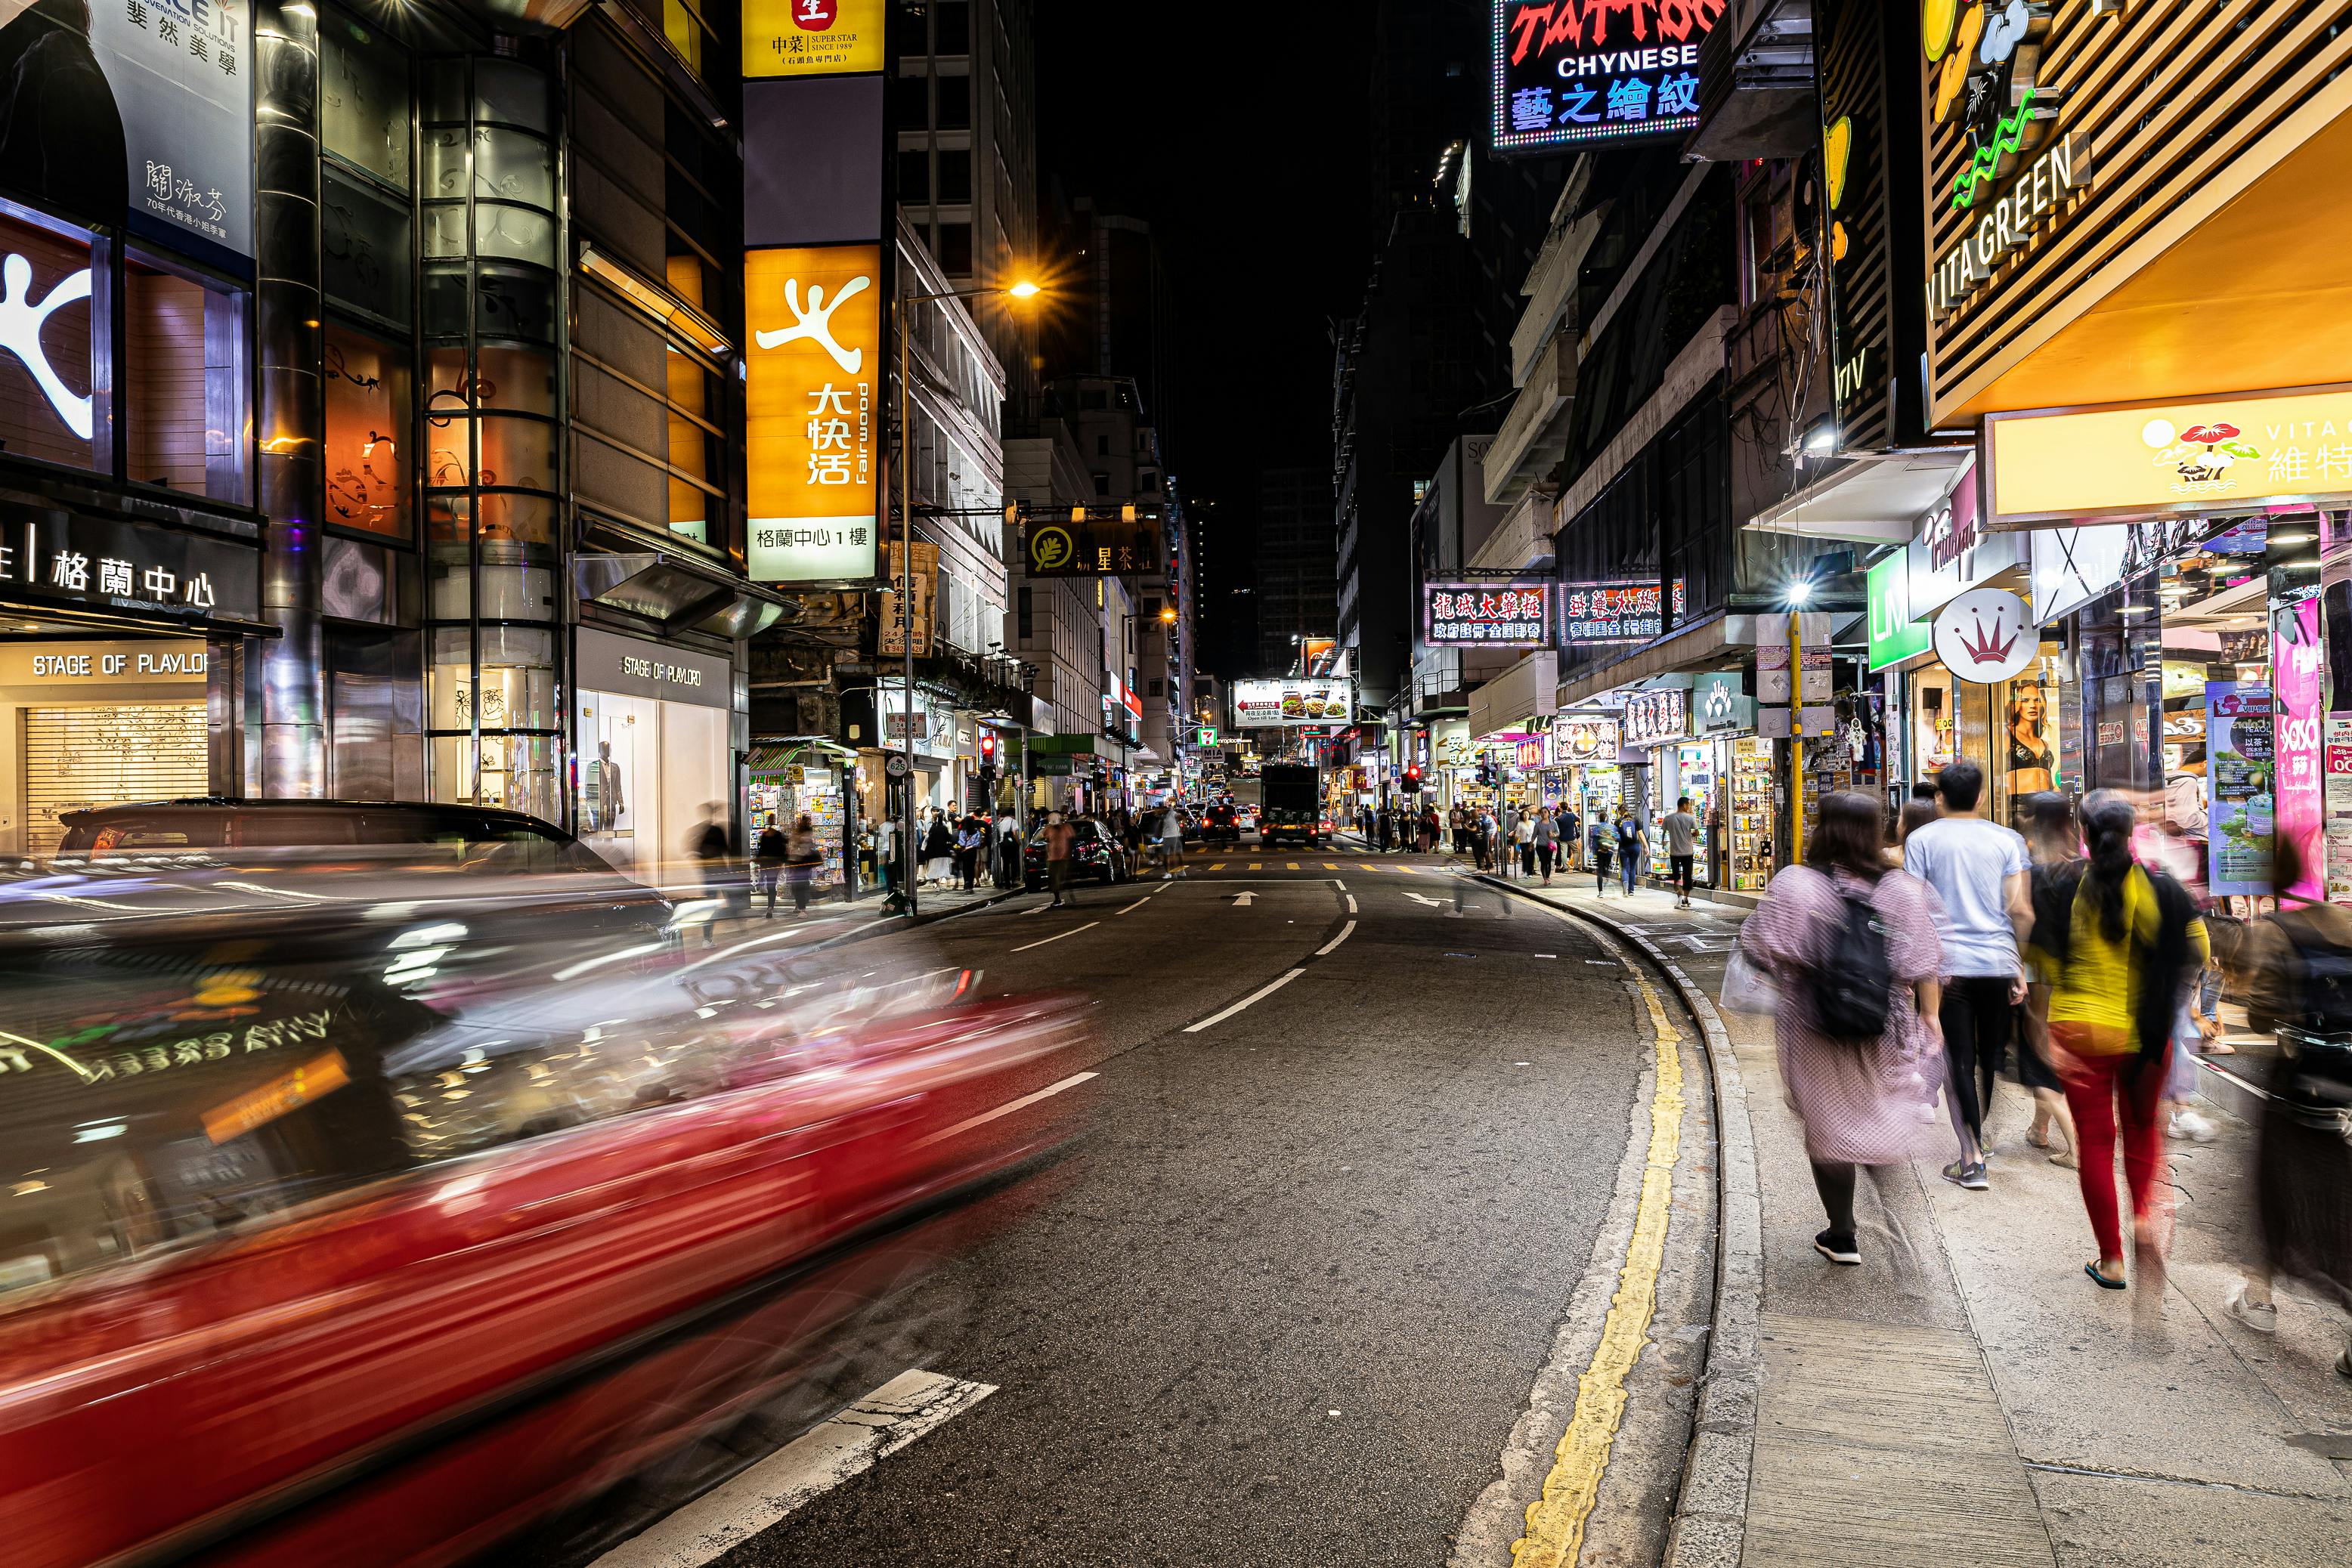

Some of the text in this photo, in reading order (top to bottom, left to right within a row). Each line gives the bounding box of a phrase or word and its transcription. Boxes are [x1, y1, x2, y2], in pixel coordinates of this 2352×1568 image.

[127, 0, 237, 76] 斐然美學
[193, 23, 236, 53] SOLUTIONS
[772, 36, 803, 54] 中菜
[812, 33, 858, 43] SUPER STAR
[1558, 43, 1698, 77] CHYNESE
[1511, 72, 1700, 131] 藝之繪紋
[146, 197, 227, 239] 70年代香港小姐季軍
[1926, 132, 2072, 322] VITA GREEN
[806, 382, 853, 485] 大快活
[2266, 420, 2337, 441] VITA
[53, 549, 215, 608] 格蘭中心
[1434, 623, 1485, 639] 政府註冊
[33, 654, 90, 675] STAGE
[102, 654, 127, 673] OF
[624, 656, 701, 687] STAGE OF PLAYLORD
[890, 762, 905, 771] 62S
